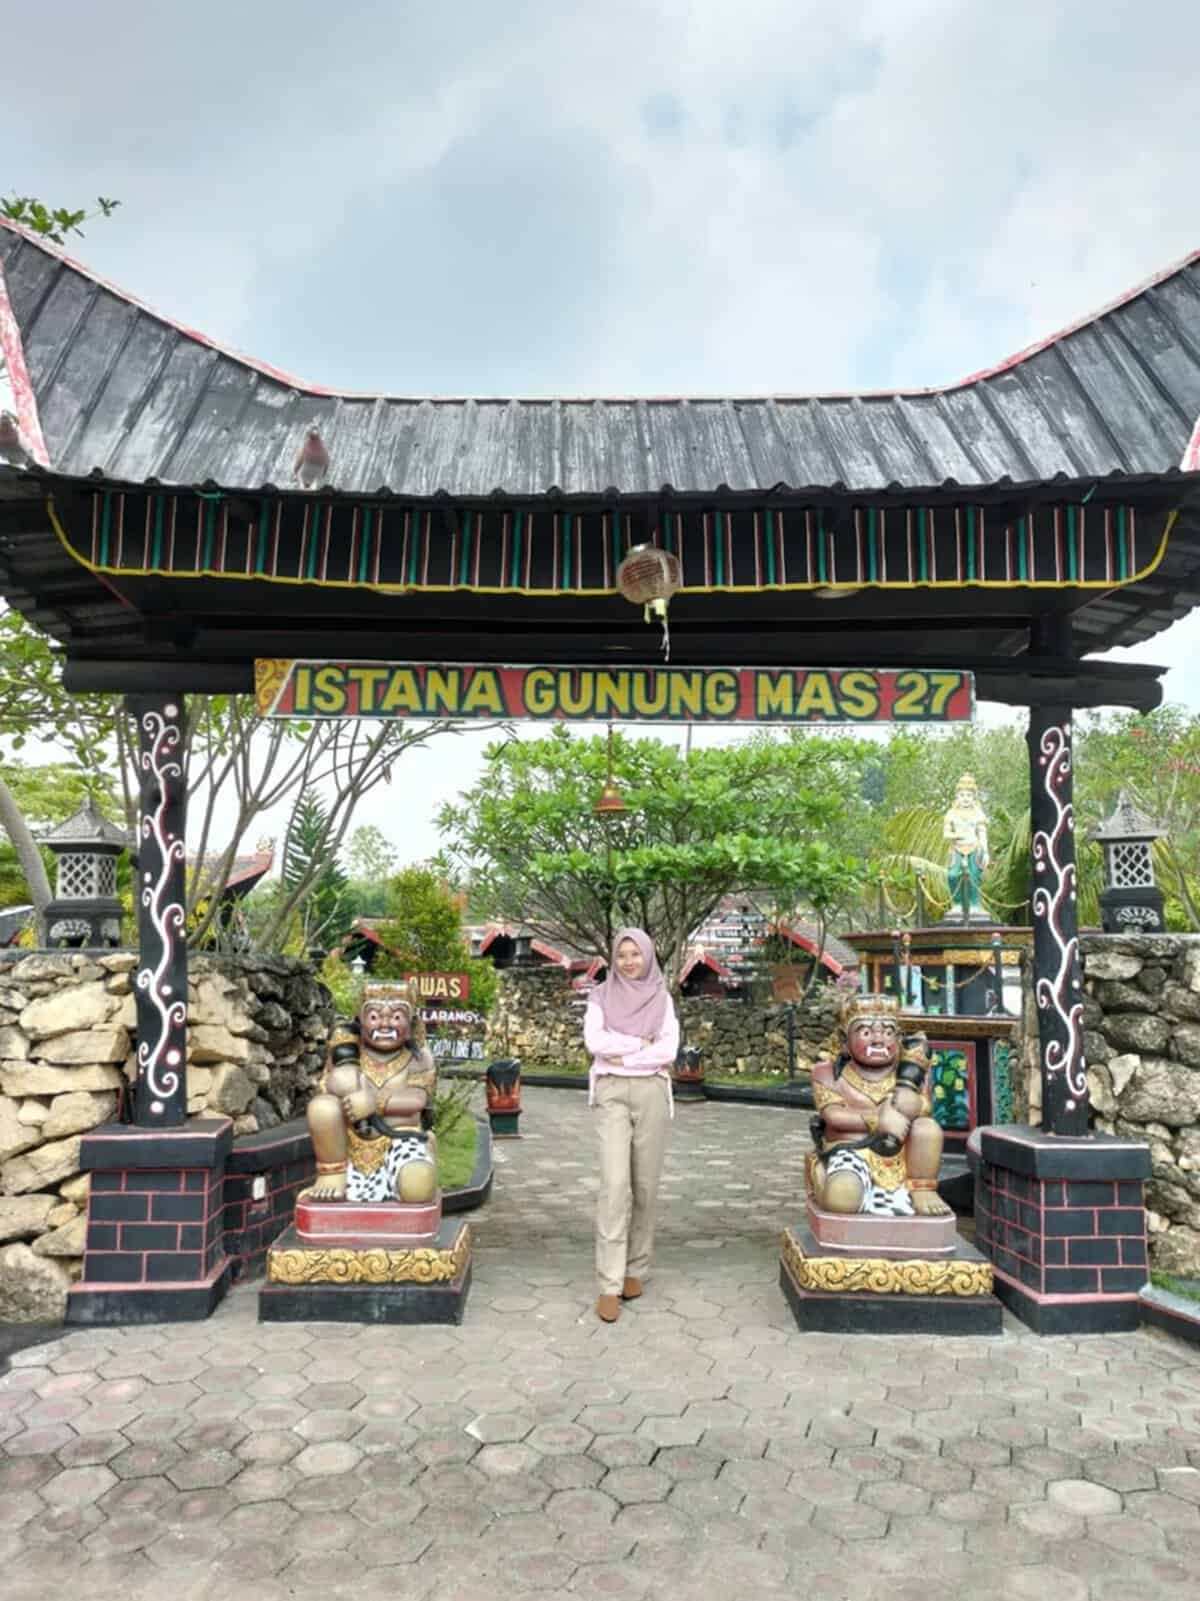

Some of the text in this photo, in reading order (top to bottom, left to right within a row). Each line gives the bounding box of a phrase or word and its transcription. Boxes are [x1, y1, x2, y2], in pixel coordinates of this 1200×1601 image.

[293, 666, 962, 718] ISTANA GUNUNG MAS 27
